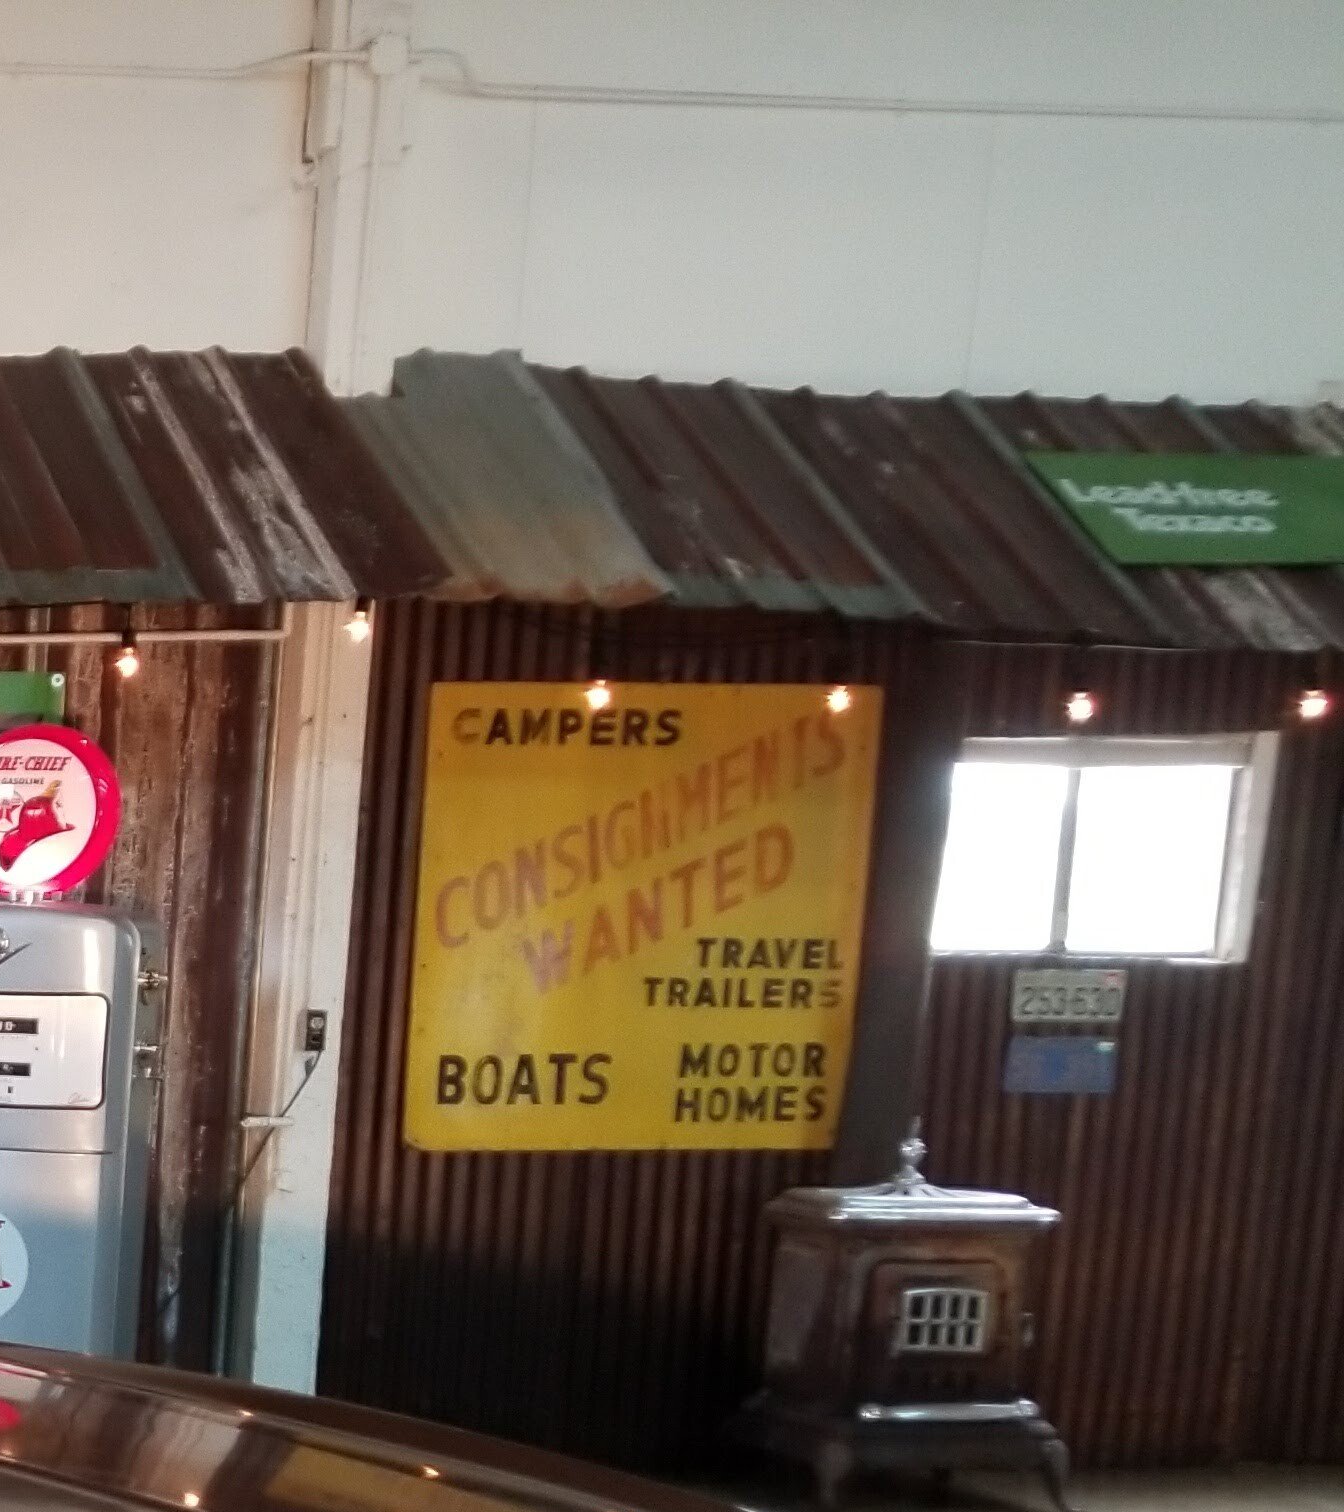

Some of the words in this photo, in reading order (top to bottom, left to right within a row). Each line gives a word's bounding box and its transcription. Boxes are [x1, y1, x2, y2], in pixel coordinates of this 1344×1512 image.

[450, 708, 683, 747] CAMPERS
[436, 712, 847, 949] CONSIGNMENTS
[519, 822, 795, 995] WANTED
[696, 937, 844, 971] TRAVEL
[643, 976, 843, 1010] TRAILERS
[436, 1052, 613, 1106] BOATS
[678, 1042, 828, 1079] MOTOR
[673, 1085, 828, 1124] HOMES
